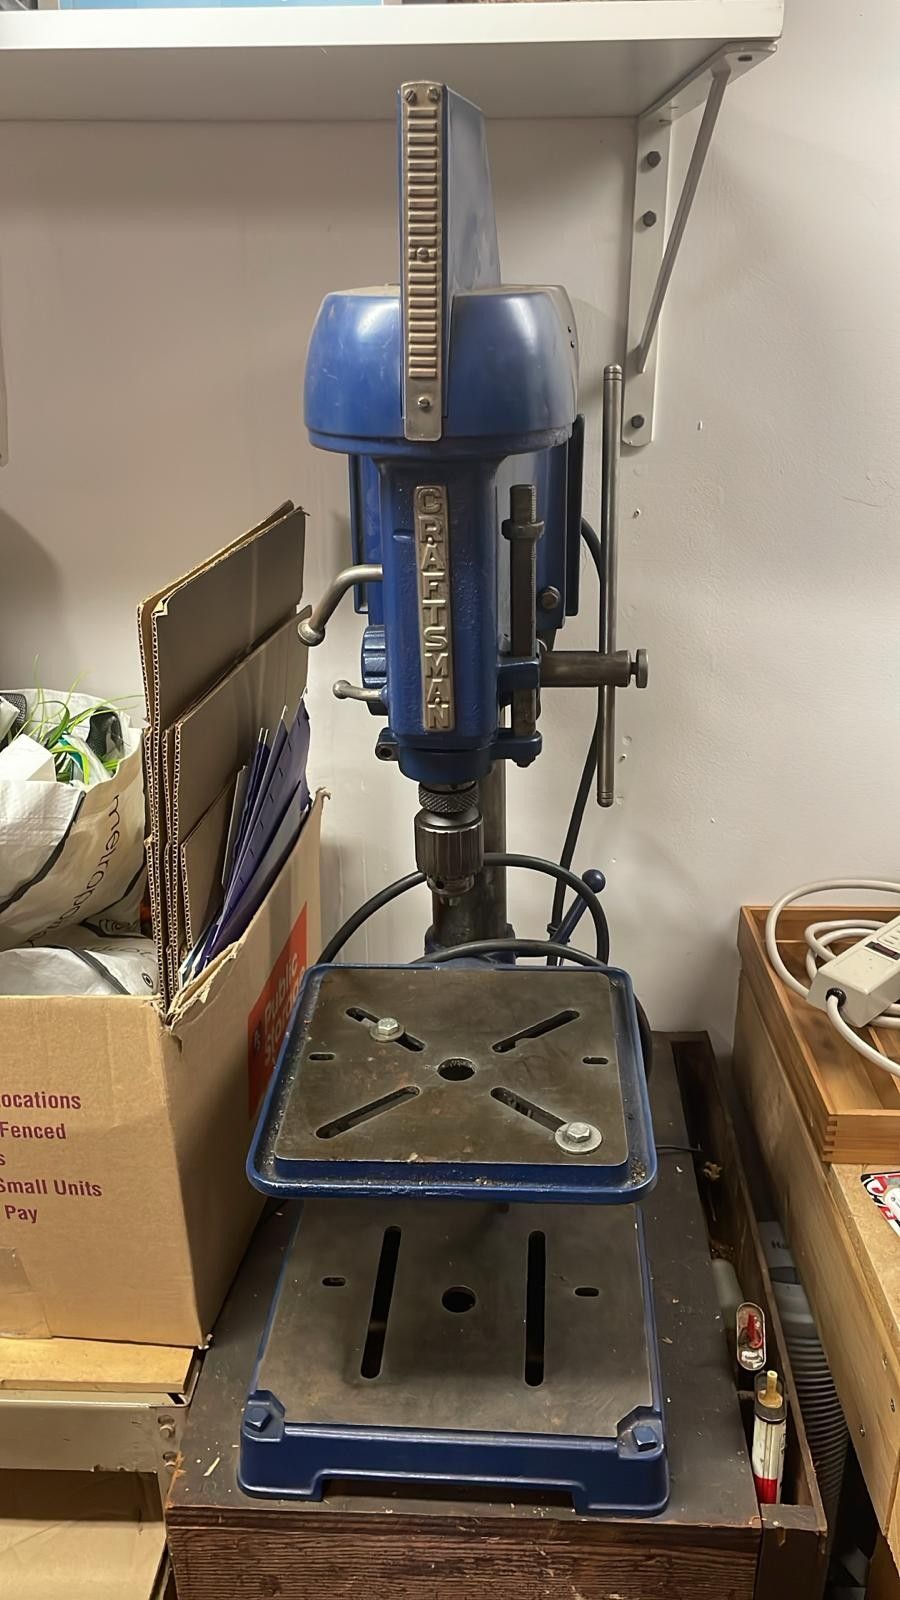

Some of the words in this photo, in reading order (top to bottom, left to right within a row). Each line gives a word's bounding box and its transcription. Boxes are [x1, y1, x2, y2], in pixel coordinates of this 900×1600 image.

[416, 487, 450, 729] CRAFTSMAN
[264, 952, 298, 1037] Public
[0, 1091, 82, 1110] ocations
[0, 1121, 67, 1140] Fenced
[53, 1179, 103, 1197] Units
[4, 1204, 38, 1224] Pay
